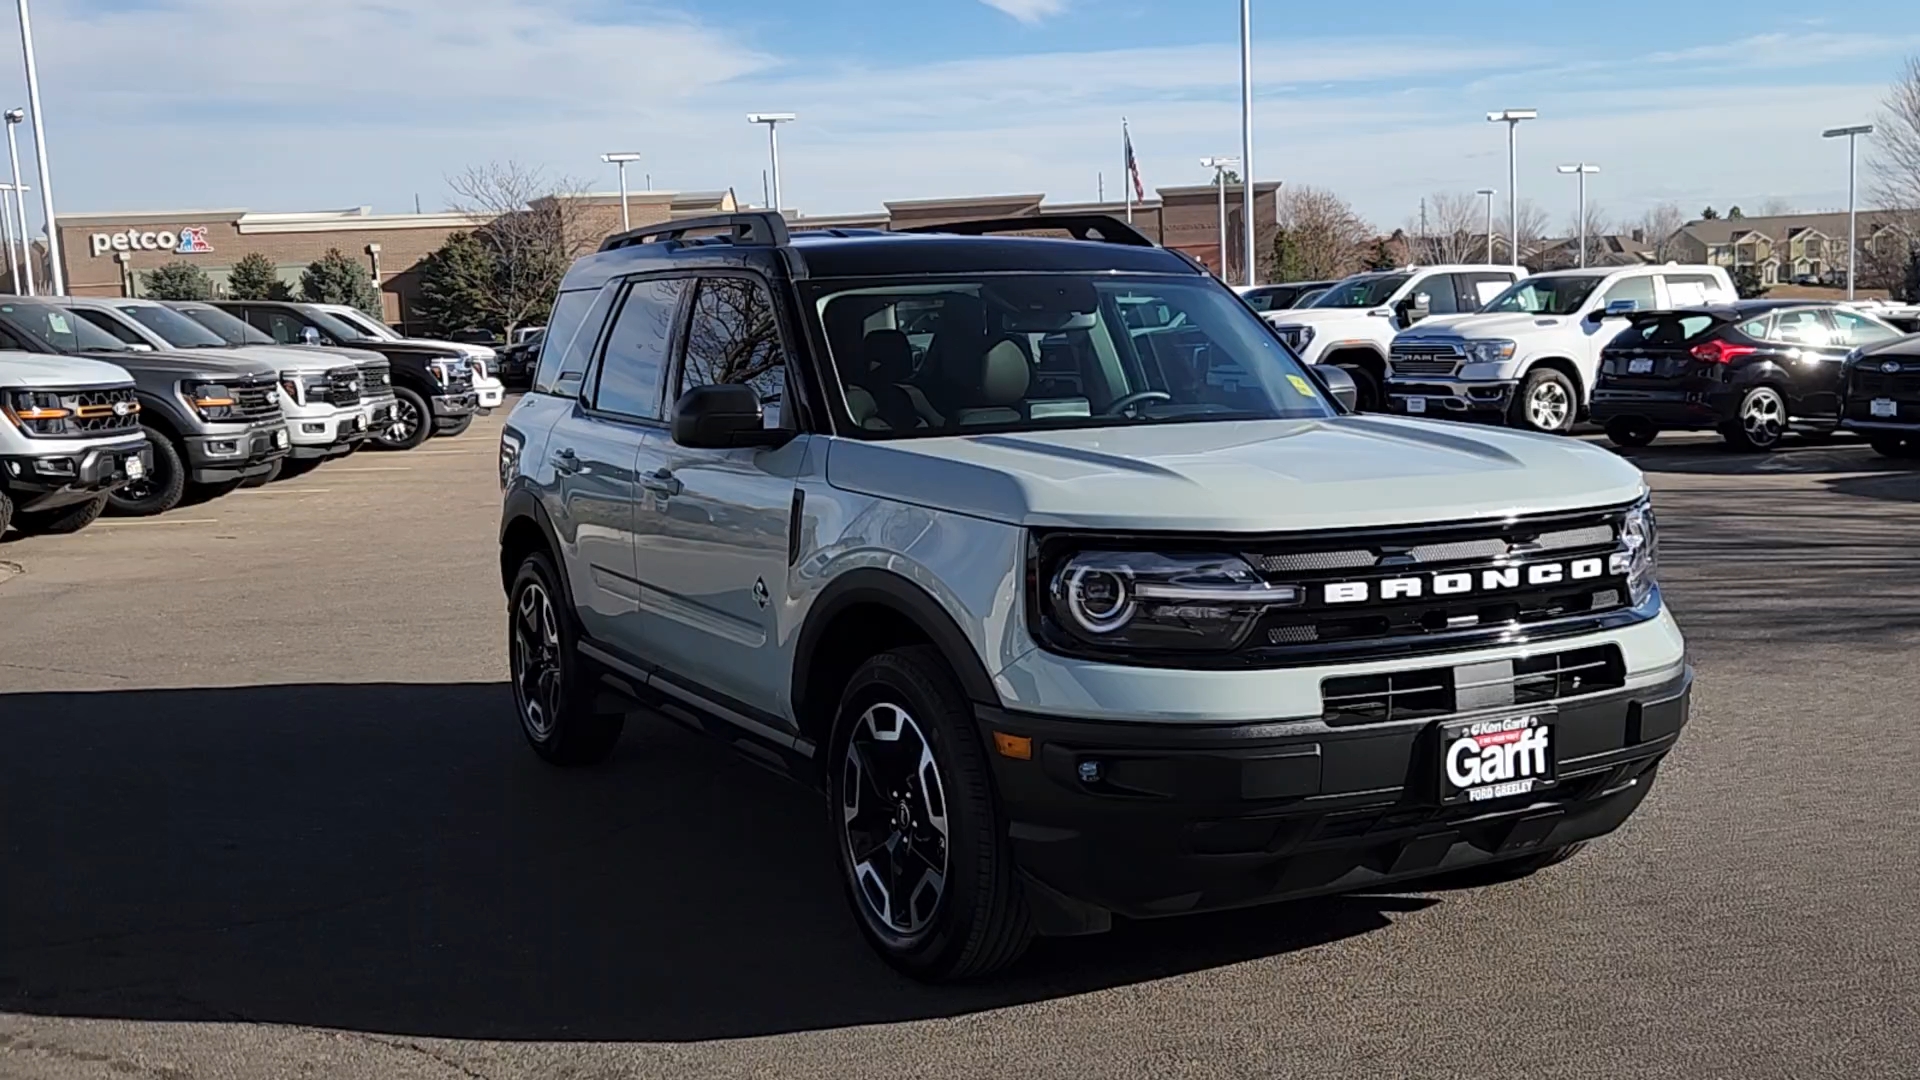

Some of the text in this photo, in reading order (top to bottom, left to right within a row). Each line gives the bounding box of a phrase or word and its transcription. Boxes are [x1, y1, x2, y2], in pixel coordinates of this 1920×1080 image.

[91, 228, 176, 257] petco
[1324, 558, 1603, 603] BRONCO
[1446, 726, 1548, 788] Garff
[1469, 780, 1533, 802] FORD GREELEY
